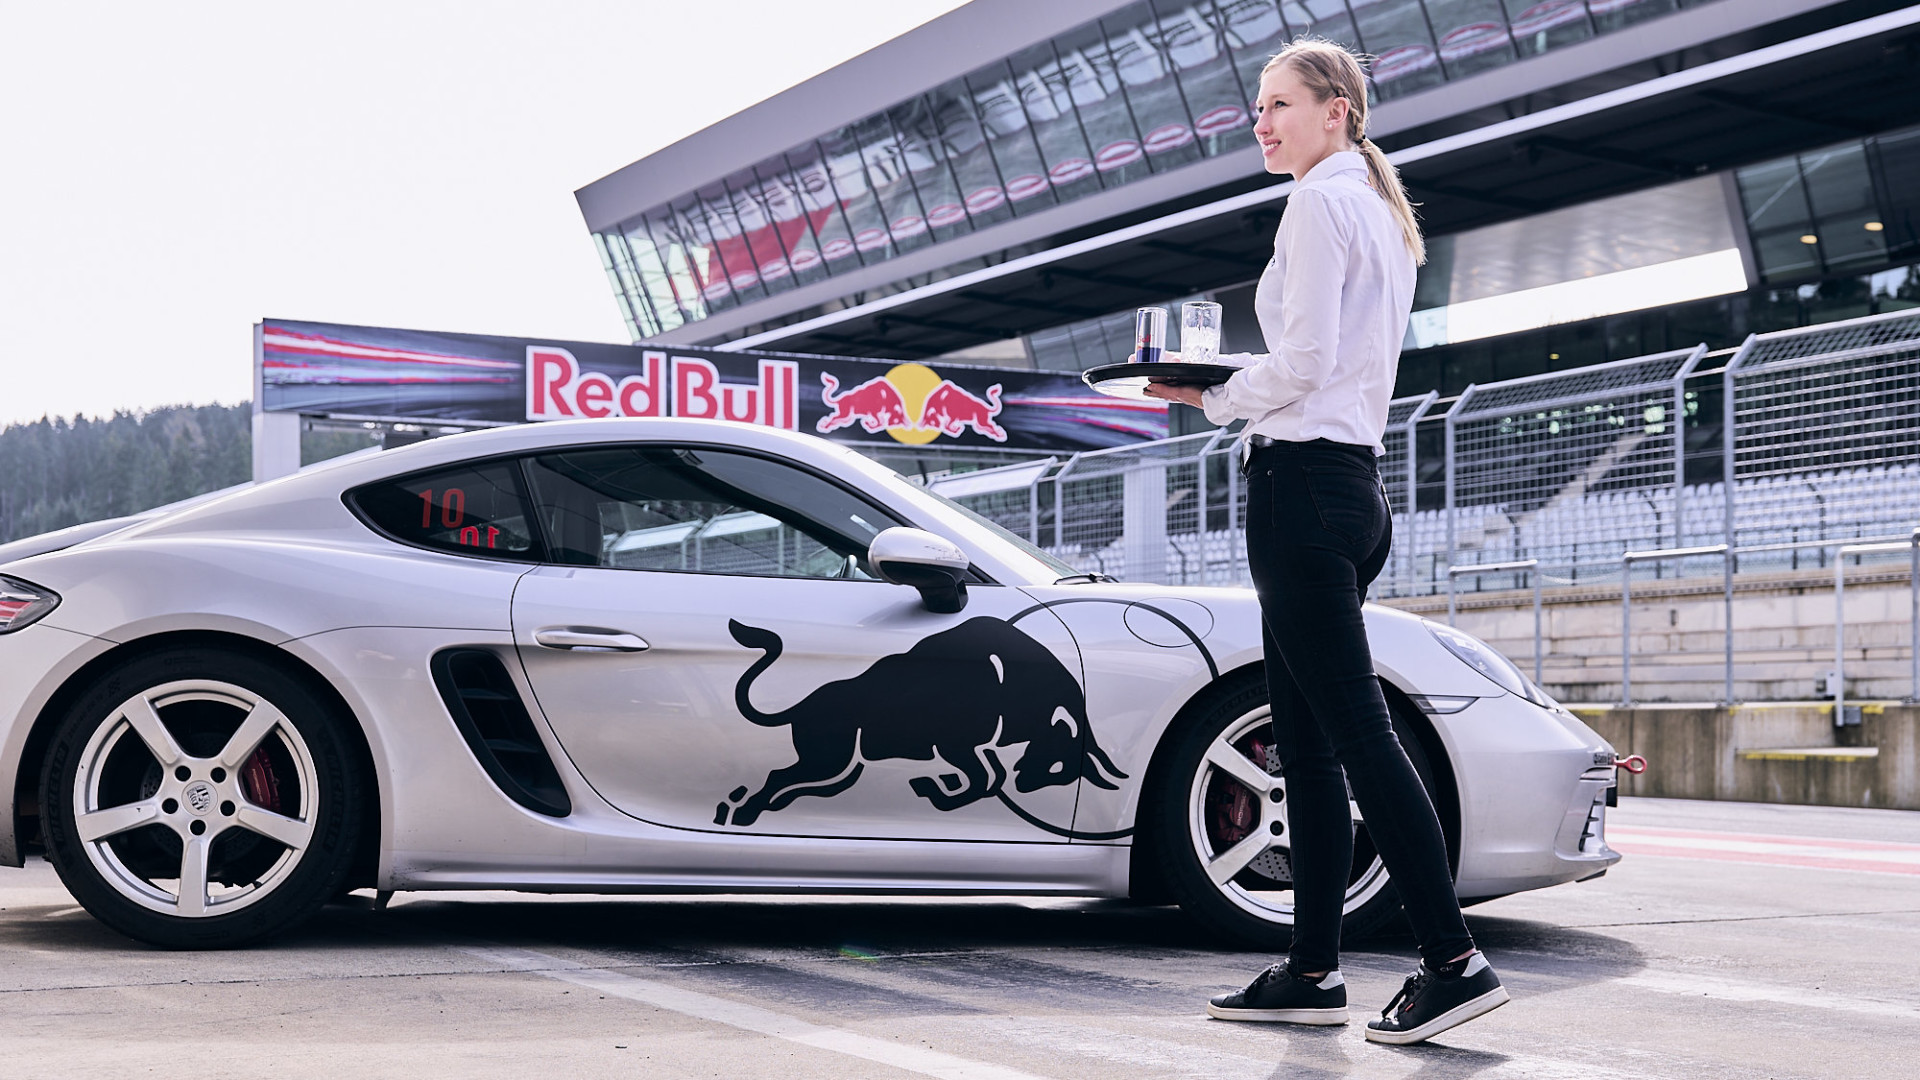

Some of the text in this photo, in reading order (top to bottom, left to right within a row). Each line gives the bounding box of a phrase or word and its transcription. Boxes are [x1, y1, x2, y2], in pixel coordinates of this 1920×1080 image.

[532, 351, 794, 429] Red Bull
[418, 488, 465, 529] 10
